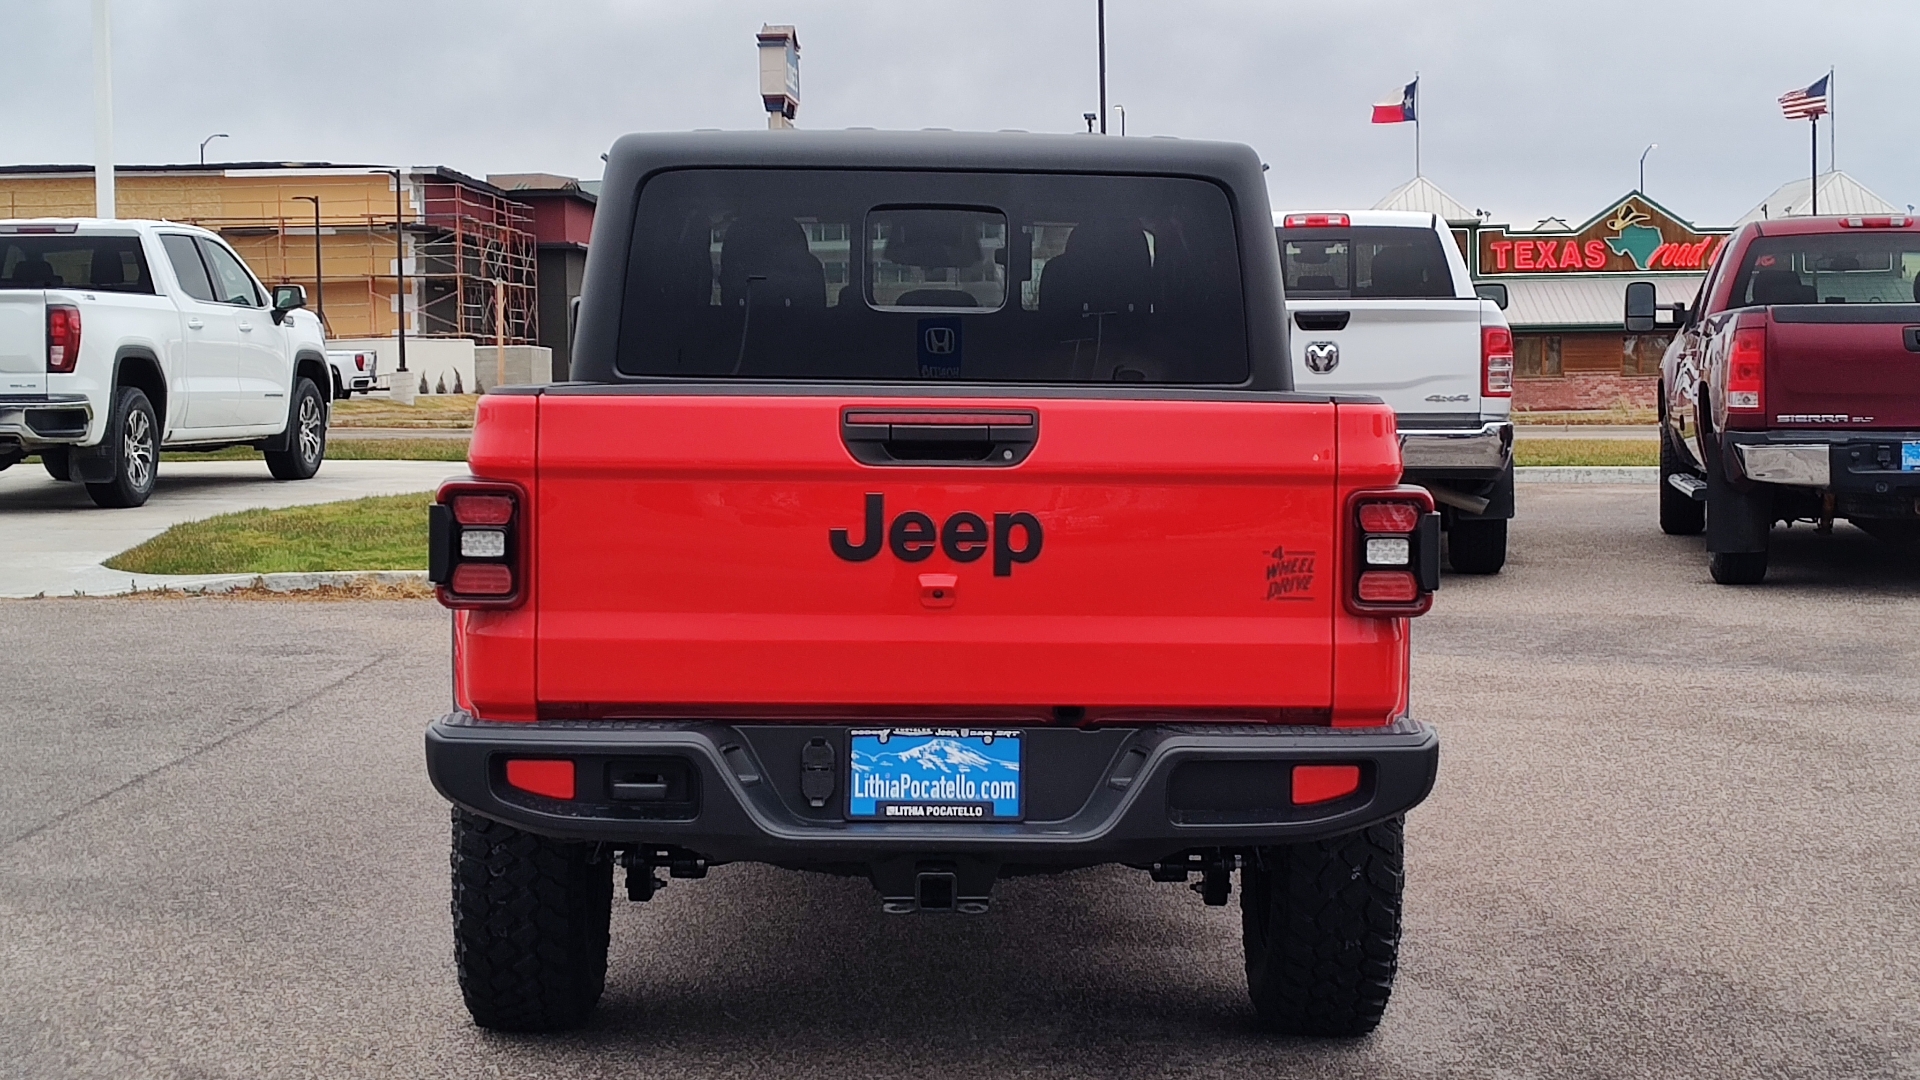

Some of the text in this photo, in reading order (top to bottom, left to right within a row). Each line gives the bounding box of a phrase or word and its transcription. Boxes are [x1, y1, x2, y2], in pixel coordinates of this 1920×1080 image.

[1490, 240, 1606, 269] TEXAS
[1647, 235, 1713, 267] road
[829, 492, 1043, 577] Jeep
[1265, 557, 1315, 581] WHEEL
[1266, 575, 1314, 601] DRIVE
[854, 773, 1016, 799] LithiaPocatello.com
[926, 805, 983, 817] POCATELLO
